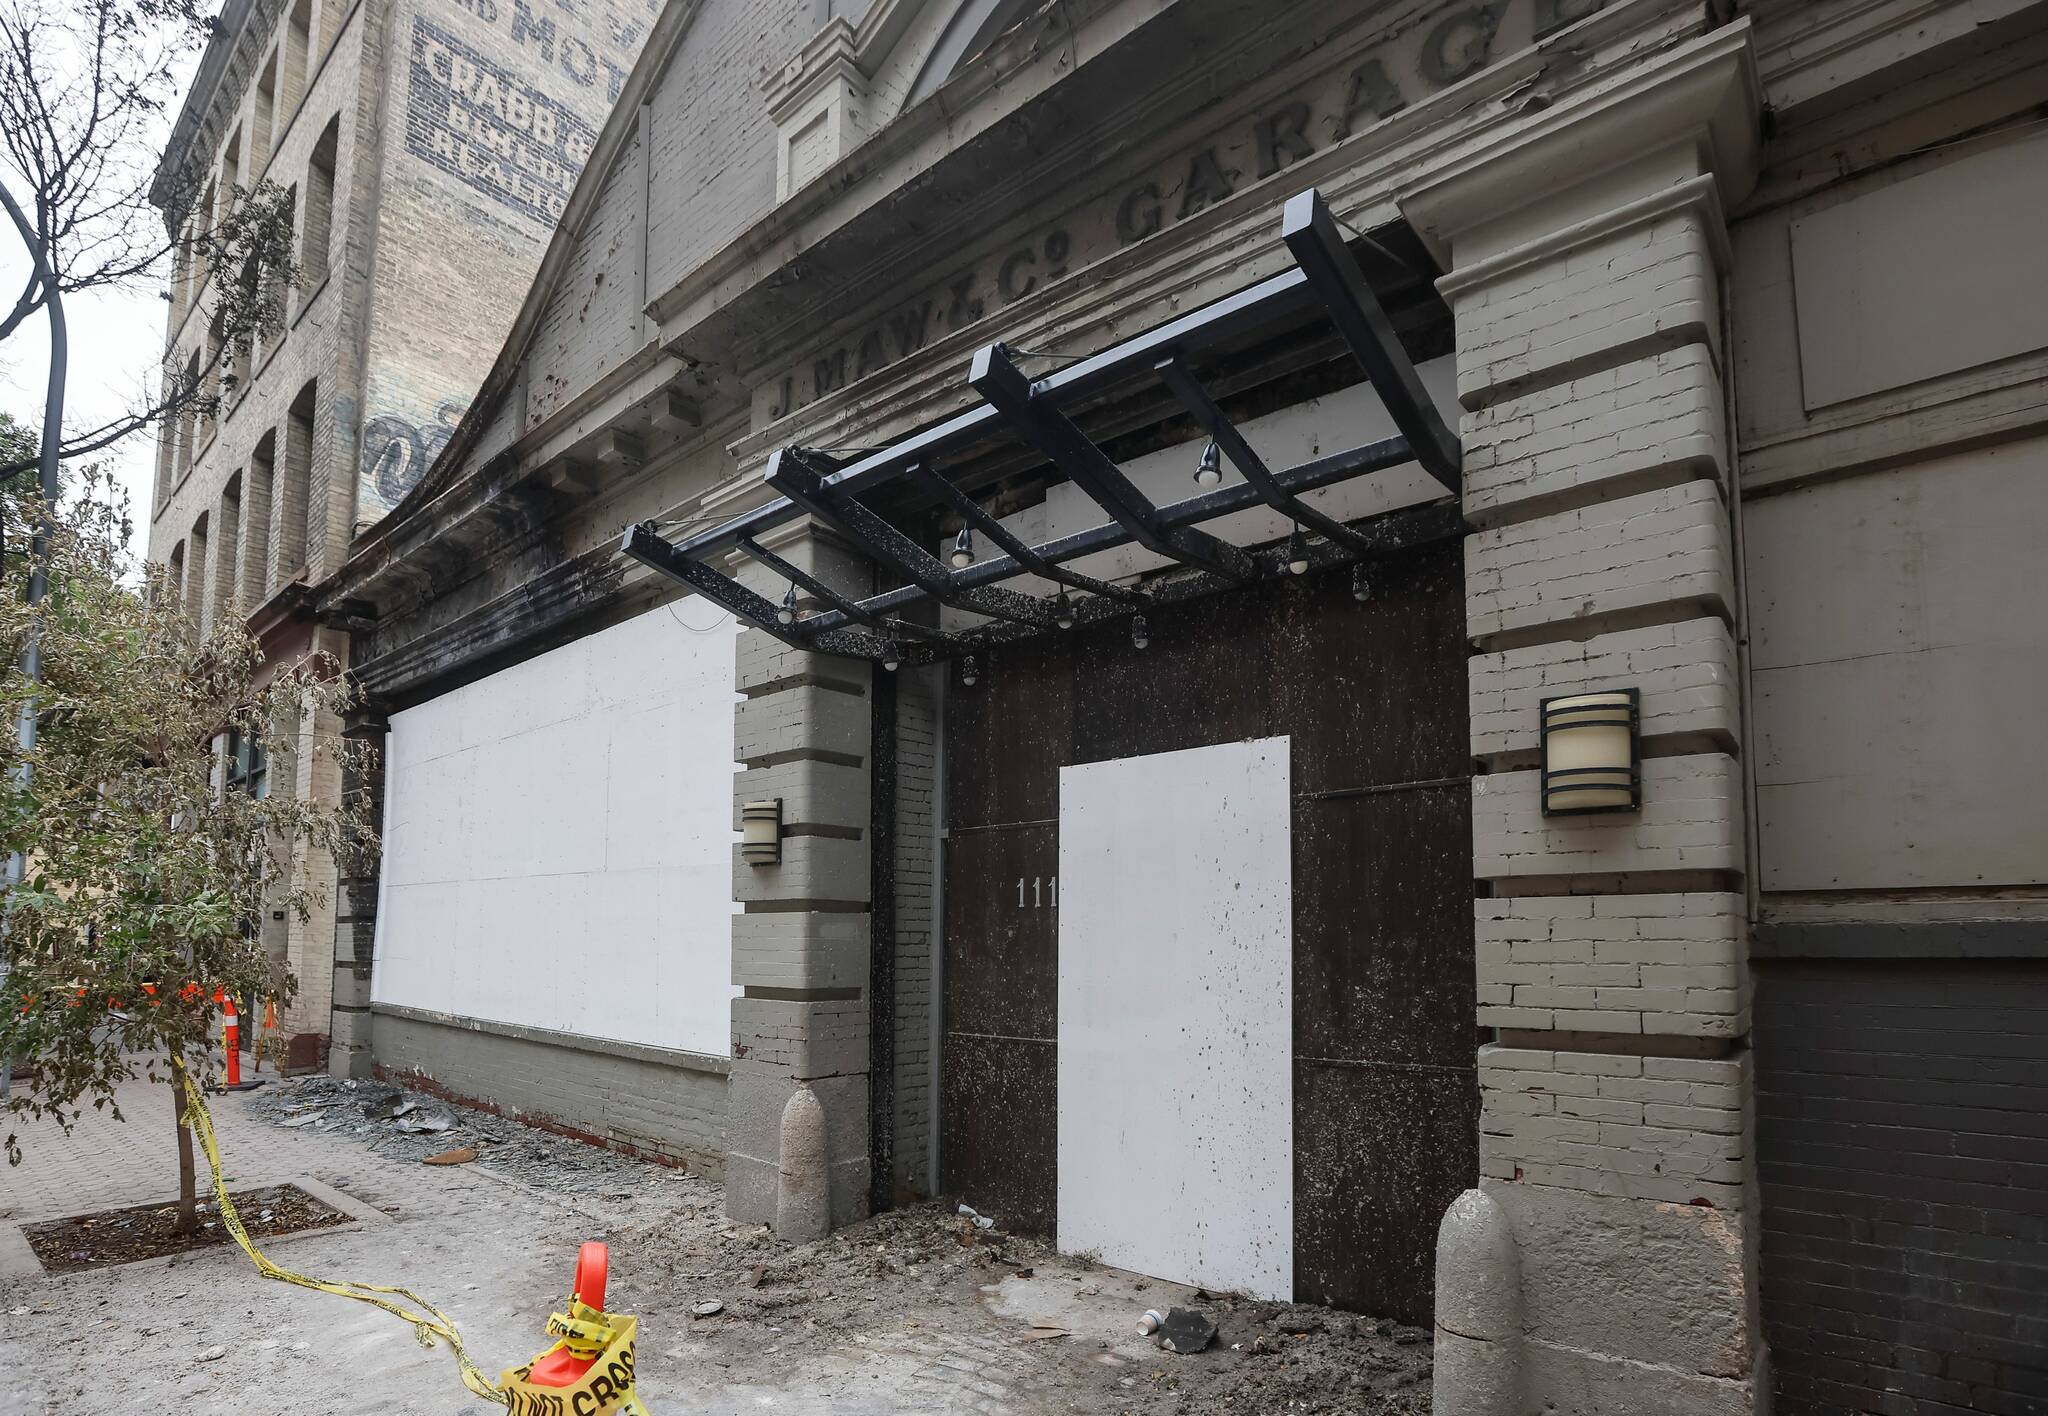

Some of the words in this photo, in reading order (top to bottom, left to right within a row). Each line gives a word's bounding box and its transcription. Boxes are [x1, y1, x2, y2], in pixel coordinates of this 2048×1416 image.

[424, 40, 557, 146] CRABB
[564, 130, 593, 164] &
[814, 300, 932, 397] MAW
[948, 273, 984, 328] &
[1016, 876, 1057, 908] 111
